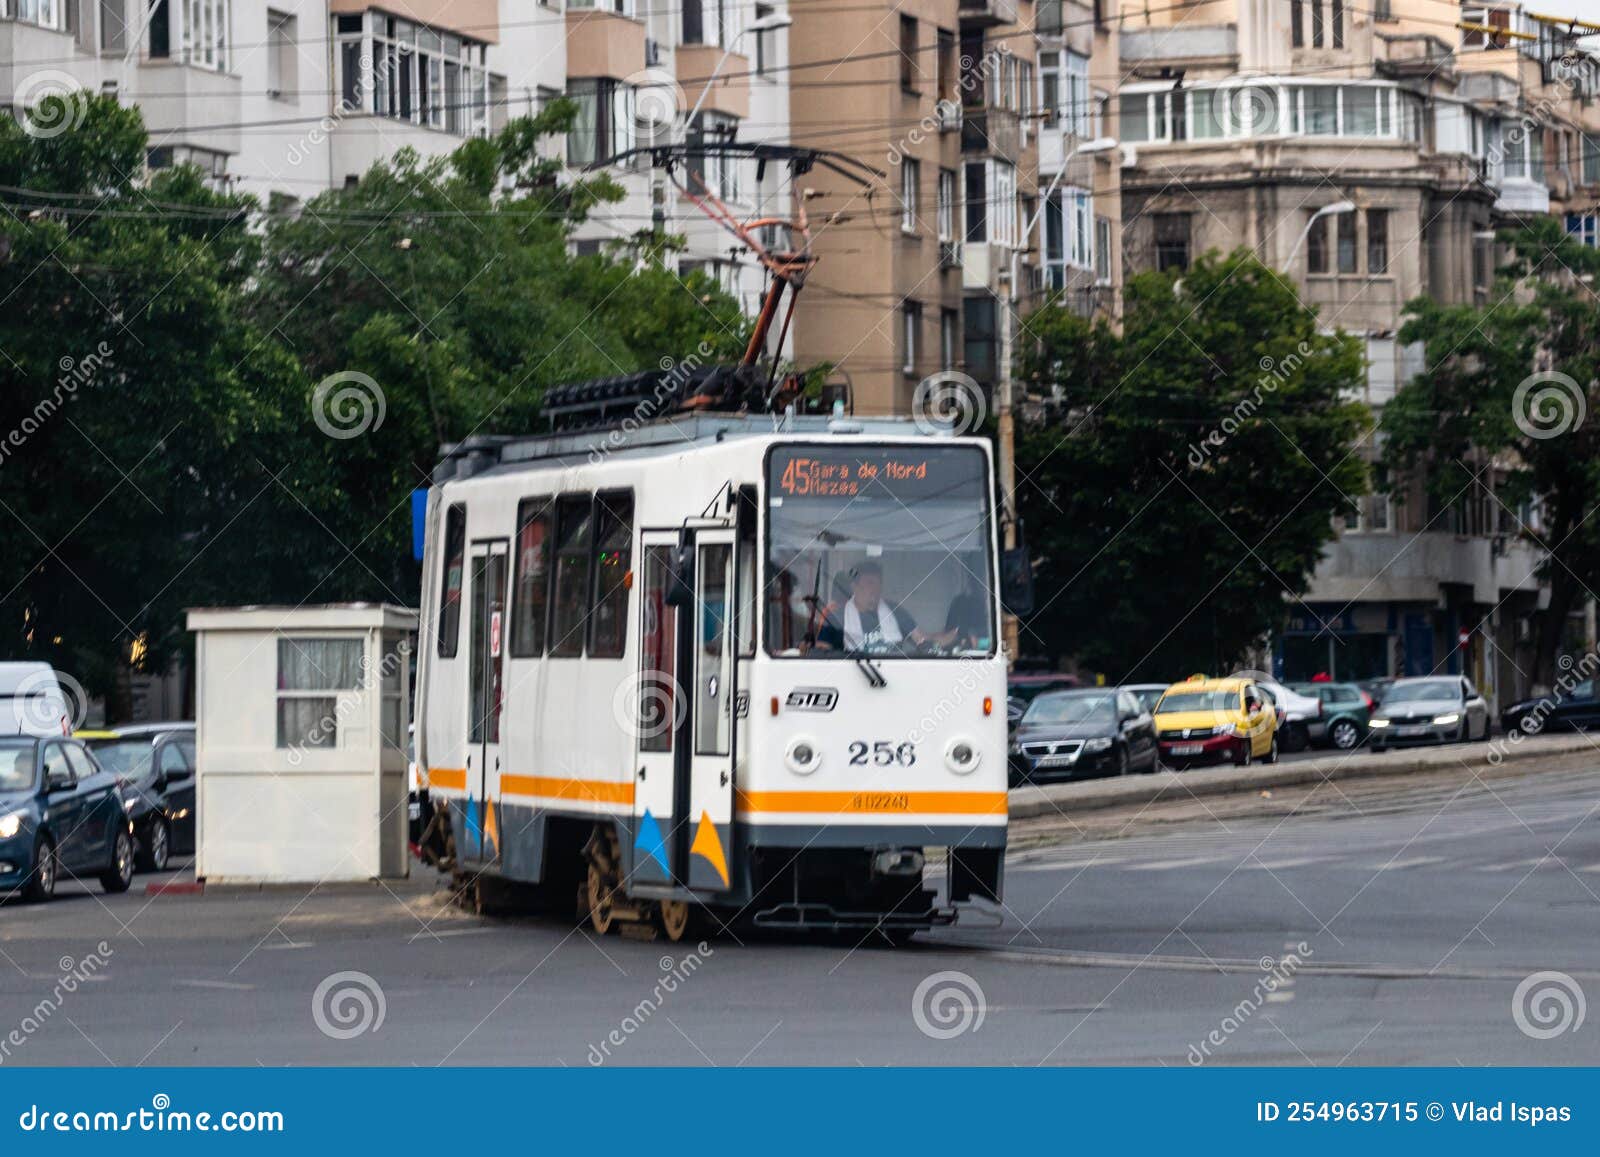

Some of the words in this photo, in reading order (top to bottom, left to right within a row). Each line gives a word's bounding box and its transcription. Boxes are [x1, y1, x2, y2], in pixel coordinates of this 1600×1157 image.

[782, 458, 809, 495] 45
[858, 461, 878, 479] de
[887, 461, 927, 479] Nord
[848, 741, 916, 768] 256
